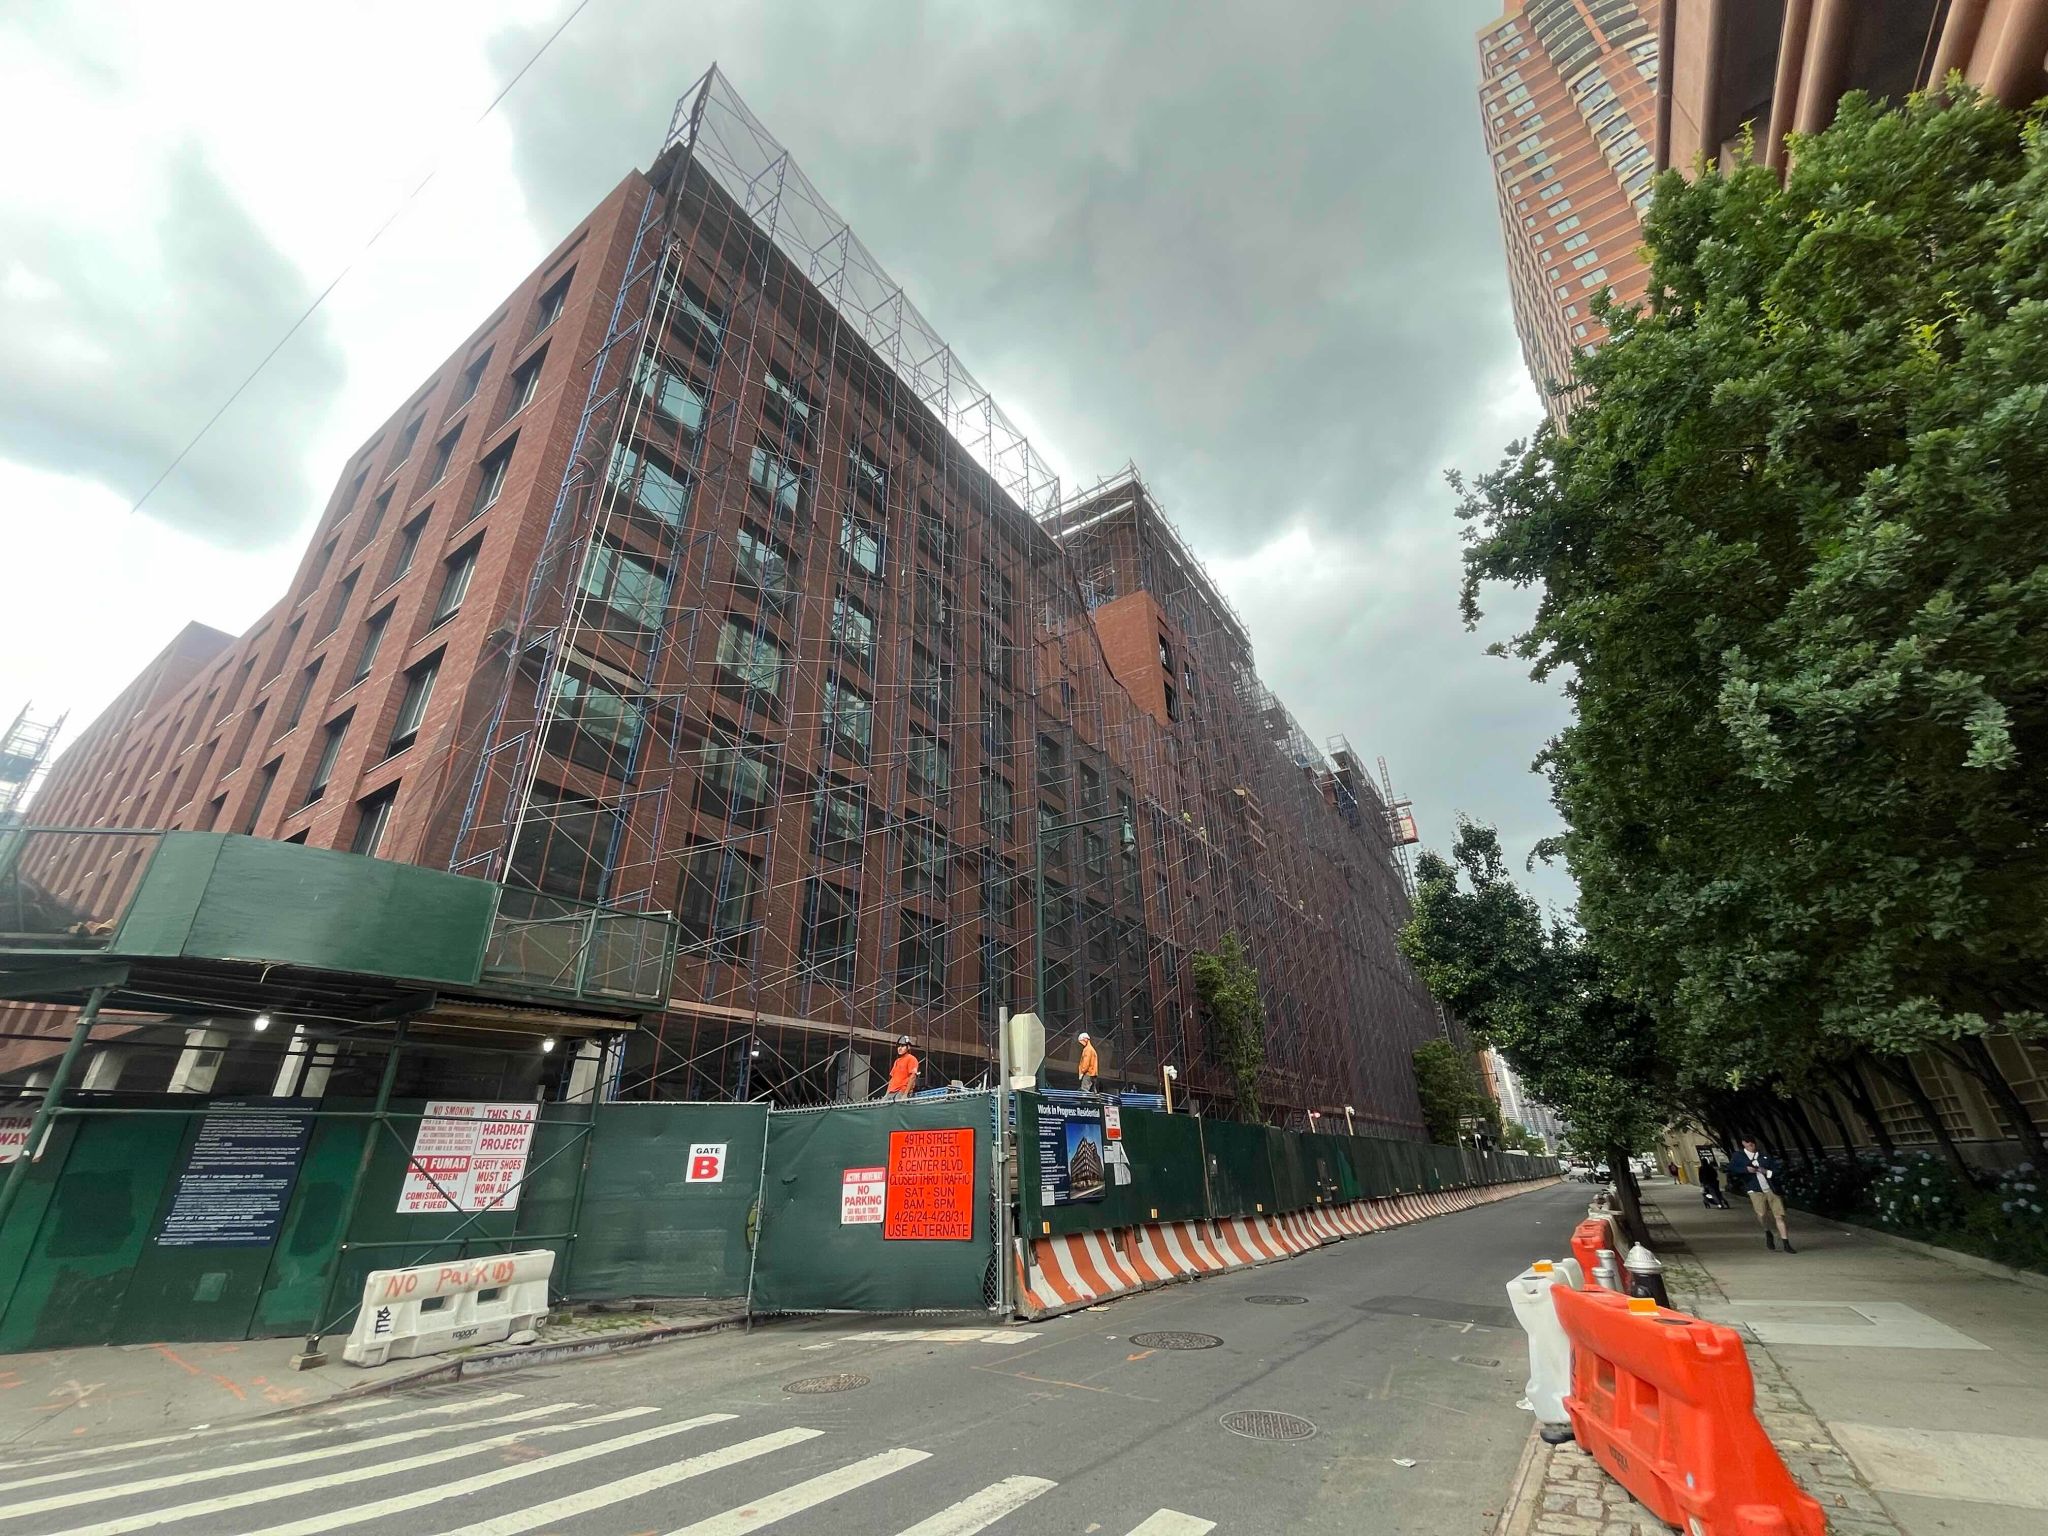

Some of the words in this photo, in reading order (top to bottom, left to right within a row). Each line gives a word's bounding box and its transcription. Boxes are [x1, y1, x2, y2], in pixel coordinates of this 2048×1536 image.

[434, 1106, 443, 1114] NO
[445, 1106, 475, 1116] SMOKING
[488, 1110, 508, 1120] THIS
[512, 1110, 521, 1120] IS
[526, 1110, 531, 1120] A
[1038, 1104, 1051, 1114] Work
[1052, 1105, 1056, 1114] in
[1077, 1108, 1100, 1117] Residential
[483, 1124, 529, 1135] HARDHAT
[905, 1134, 924, 1145] 49TH
[927, 1132, 958, 1144] STREET
[480, 1139, 525, 1150] PROJECT
[901, 1147, 927, 1158] BTWN
[930, 1146, 946, 1158] 5TH
[949, 1146, 960, 1157] ST
[430, 1158, 467, 1169] FUMAR
[474, 1160, 498, 1169] SAFETY
[500, 1160, 521, 1169] SHOES
[692, 1157, 718, 1179] B
[898, 1161, 903, 1171] &
[906, 1160, 938, 1172] CENTER
[941, 1159, 963, 1171] BLVD
[477, 1172, 499, 1182] MUST
[502, 1172, 512, 1181] BE
[890, 1174, 917, 1186] CLOSED
[920, 1174, 938, 1185] THRU
[942, 1173, 969, 1185] TRAFFIC
[474, 1184, 495, 1193] WORN
[858, 1185, 869, 1195] NO
[905, 1188, 924, 1197] SAT
[934, 1187, 954, 1197] SUN
[474, 1197, 487, 1206] THE
[845, 1196, 881, 1206] PARKING
[904, 1200, 924, 1209] 8AM
[934, 1199, 955, 1209] 6PM
[895, 1211, 964, 1222] 4/26/24-4/28/31
[889, 1224, 907, 1236] USE
[910, 1224, 968, 1236] ALTERNATE
[385, 1274, 418, 1298] NO
